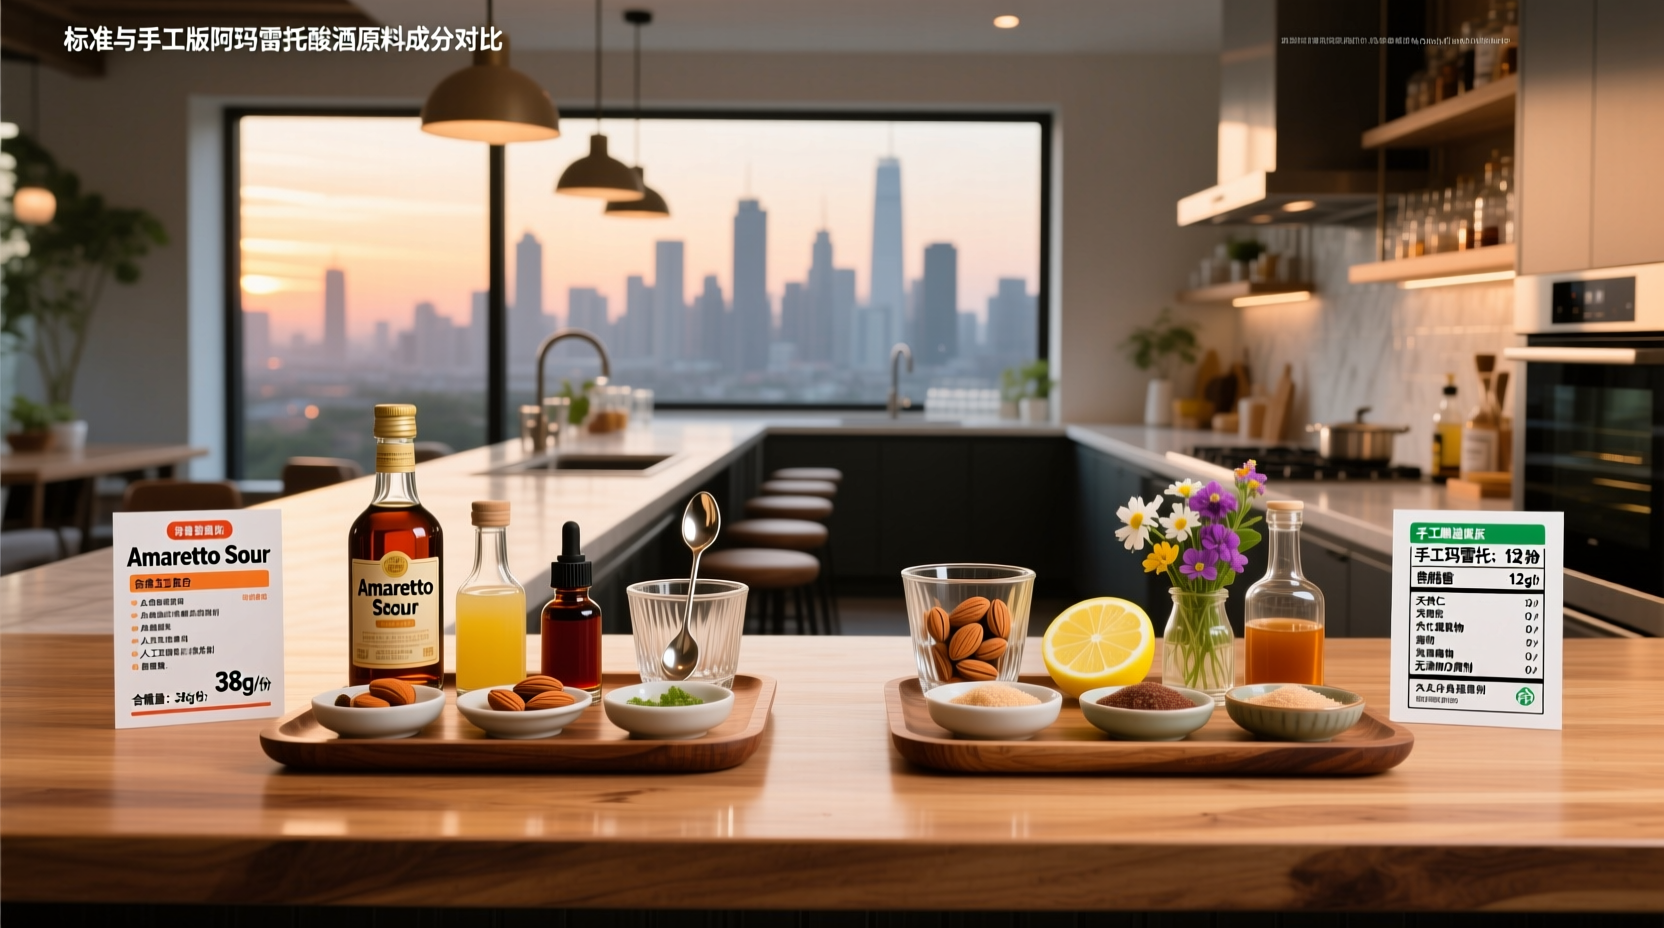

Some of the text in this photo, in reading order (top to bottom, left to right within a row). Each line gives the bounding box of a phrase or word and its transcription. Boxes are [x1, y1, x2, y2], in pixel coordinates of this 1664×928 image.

[127, 545, 271, 567] Amaretto Sour
[357, 578, 434, 596] Amaretto
